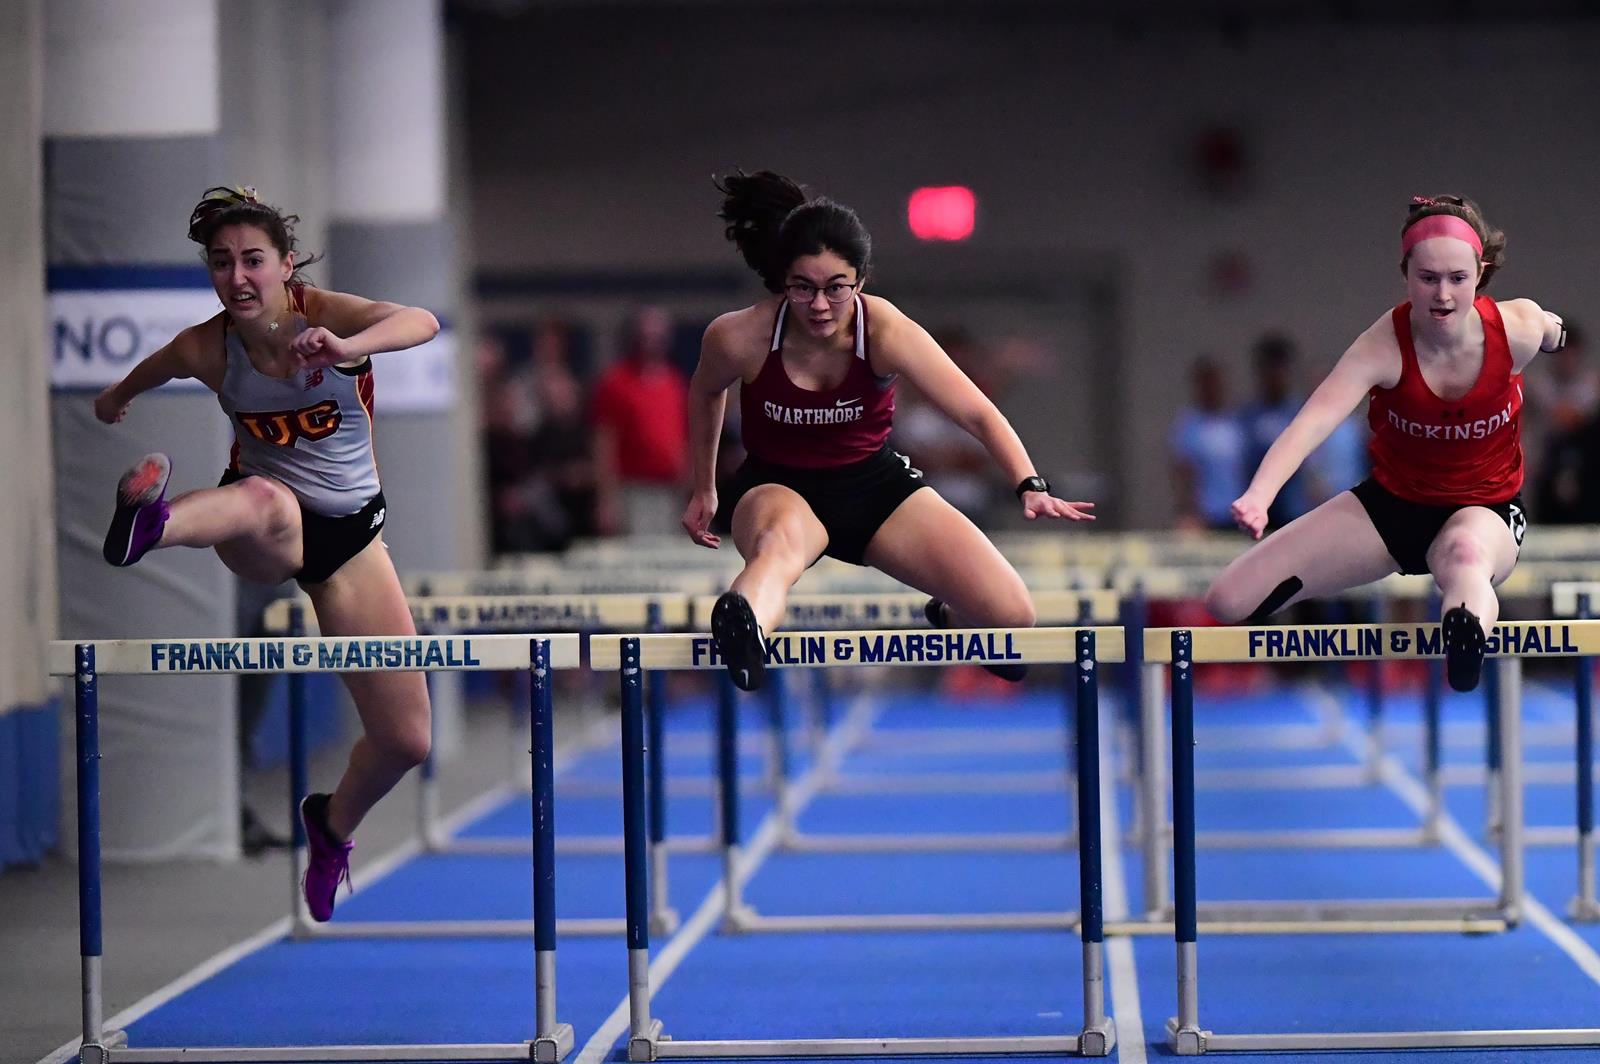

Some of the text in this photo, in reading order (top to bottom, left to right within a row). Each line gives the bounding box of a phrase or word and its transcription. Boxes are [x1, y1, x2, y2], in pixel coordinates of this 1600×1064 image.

[53, 316, 141, 365] NO
[235, 399, 342, 449] UC
[764, 400, 864, 425] SWARTHMORE
[1388, 401, 1513, 440] DICKINSON
[151, 639, 480, 671] FRANKLIN & MARSHALL
[692, 633, 1021, 666] FRKLIN & MARSHALL
[1249, 626, 1578, 657] FRANKLIN & MSHALL
